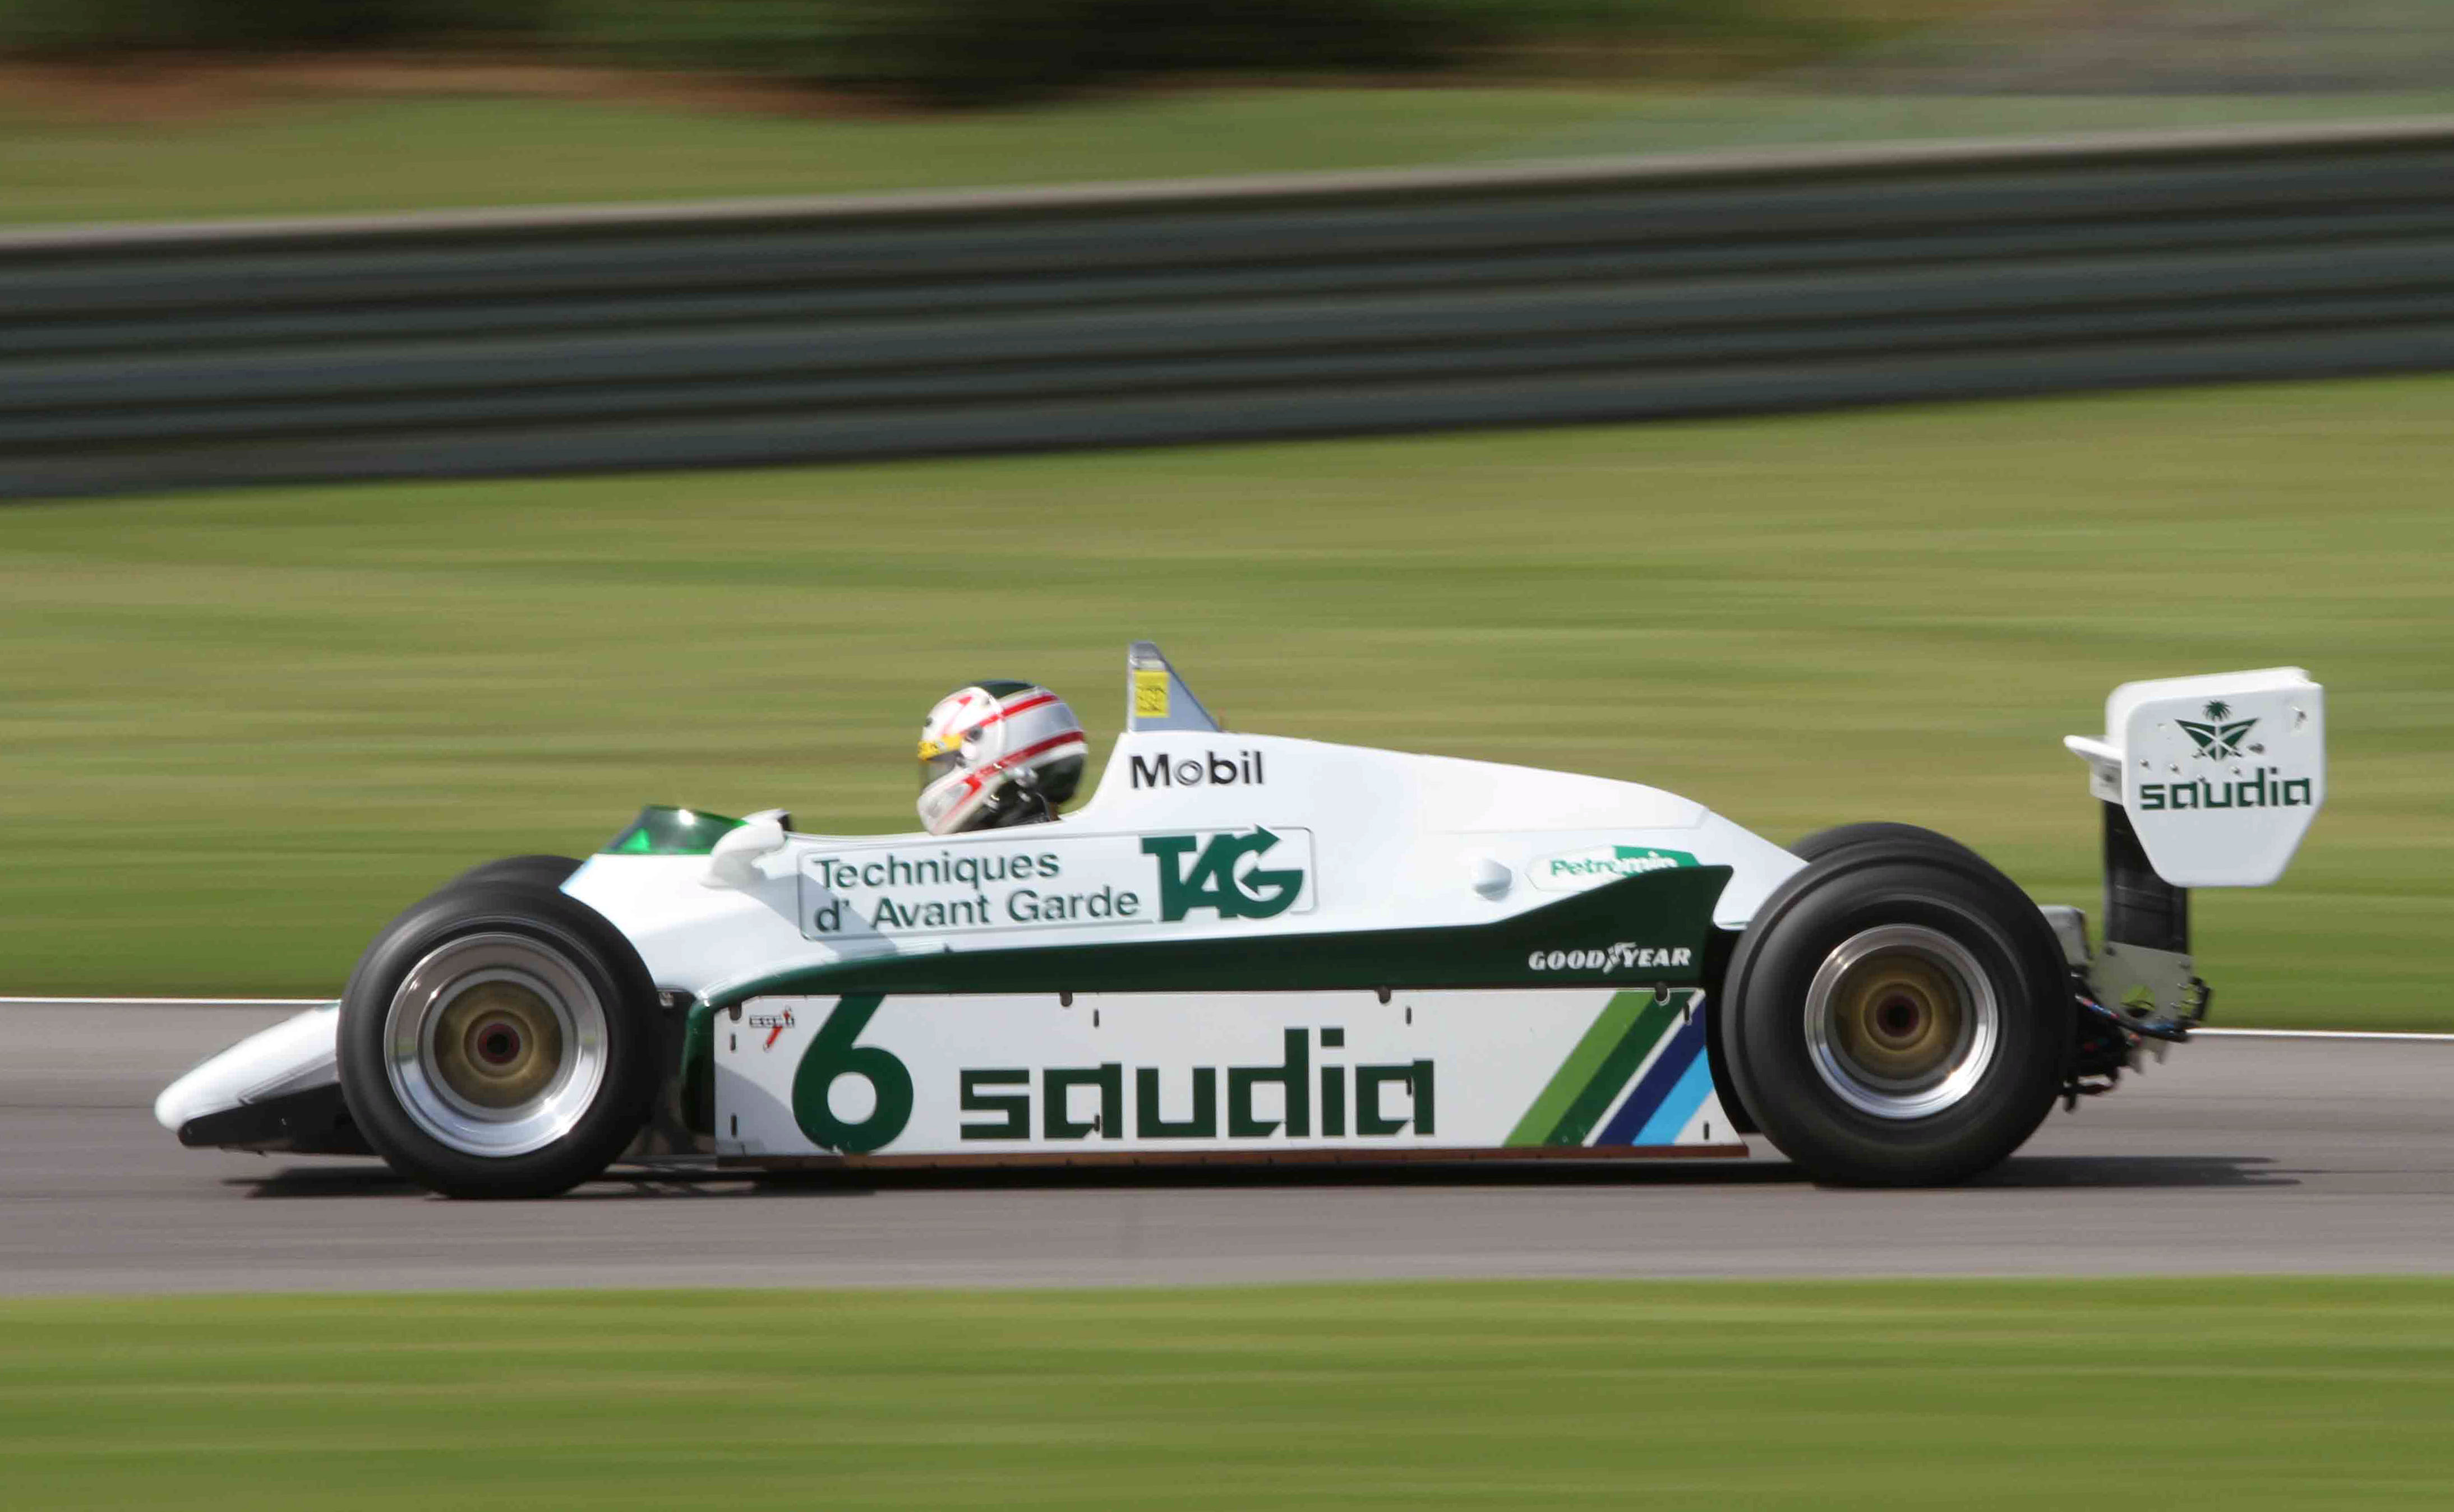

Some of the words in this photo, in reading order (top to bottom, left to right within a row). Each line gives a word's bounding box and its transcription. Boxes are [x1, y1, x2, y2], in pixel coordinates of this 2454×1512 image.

[1128, 750, 1263, 788] Mobil
[2139, 767, 2312, 810] saudia
[813, 851, 1060, 889] Techniques
[1141, 824, 1304, 922] TAG
[871, 896, 991, 929] Avant
[1007, 885, 1140, 922] Garde
[792, 994, 914, 1155] 6
[960, 1027, 1434, 1140] saudia
